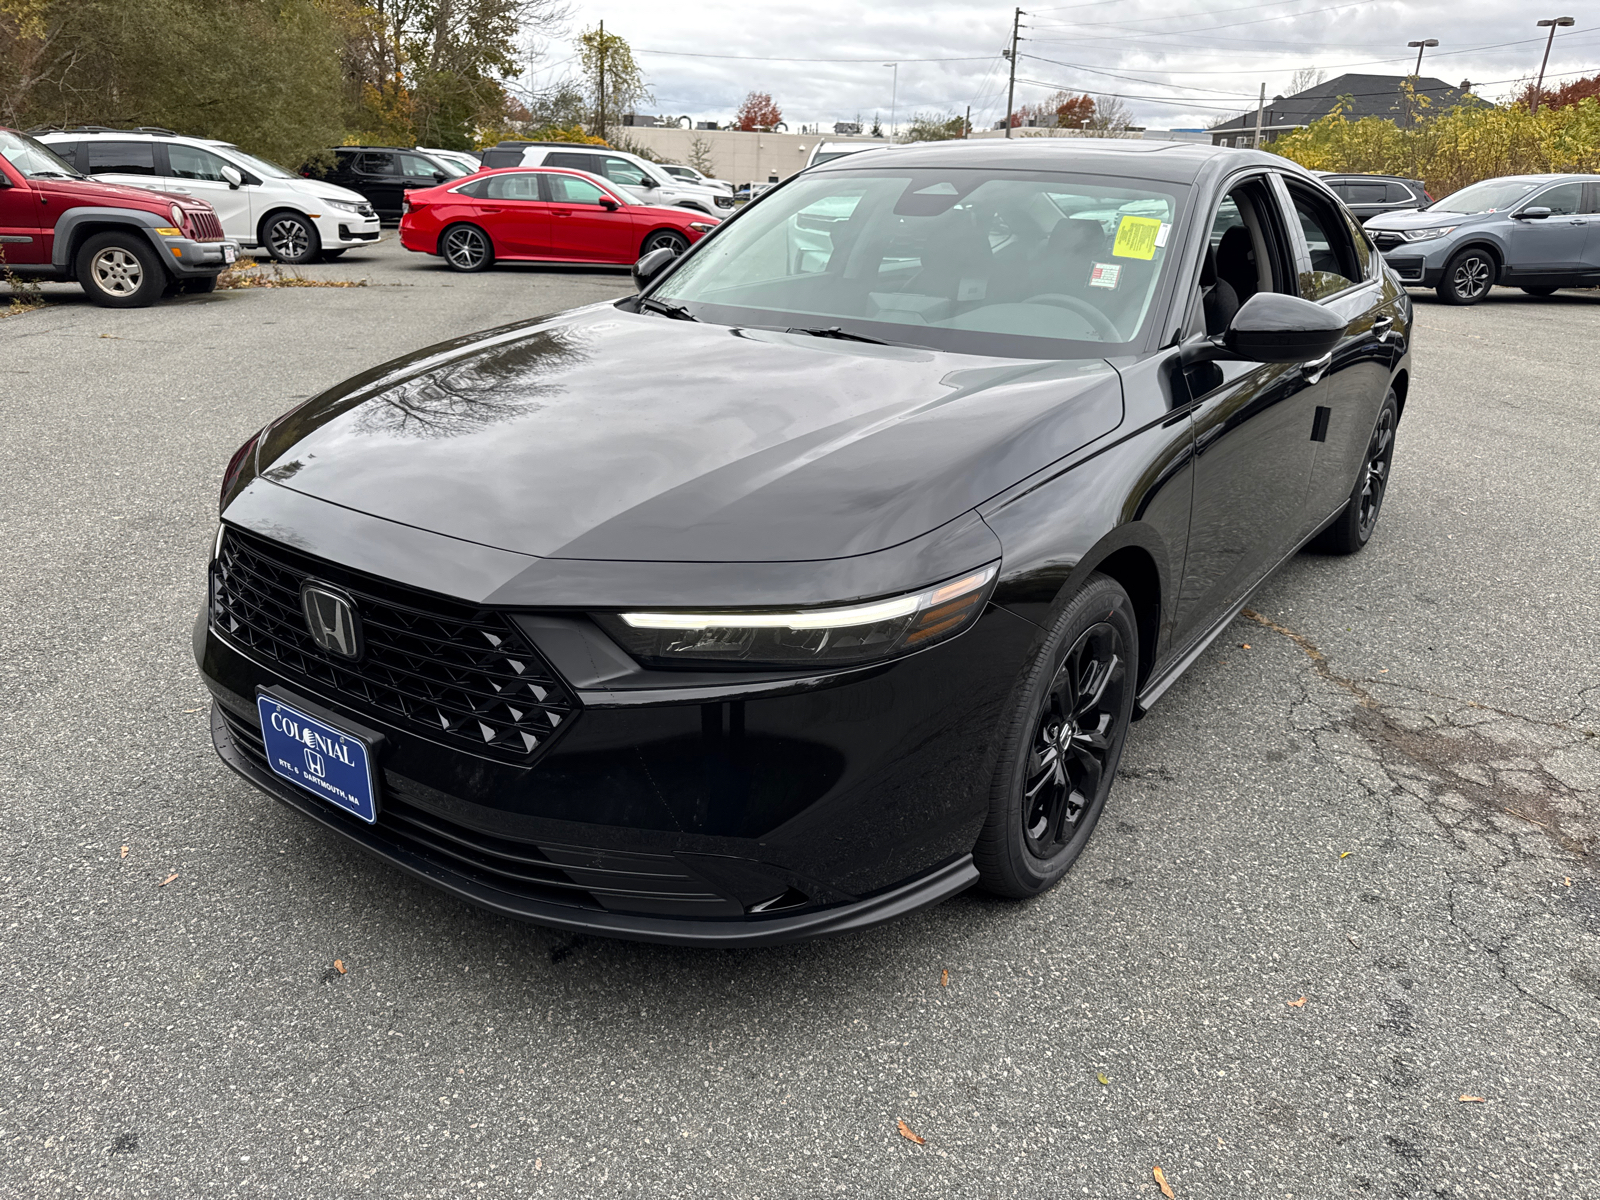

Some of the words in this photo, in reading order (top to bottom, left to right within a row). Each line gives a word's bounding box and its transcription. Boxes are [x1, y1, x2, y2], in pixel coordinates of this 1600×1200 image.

[271, 712, 355, 767] COLONIAL
[303, 771, 348, 800] DARTMOUTH,
[348, 794, 360, 806] MA
